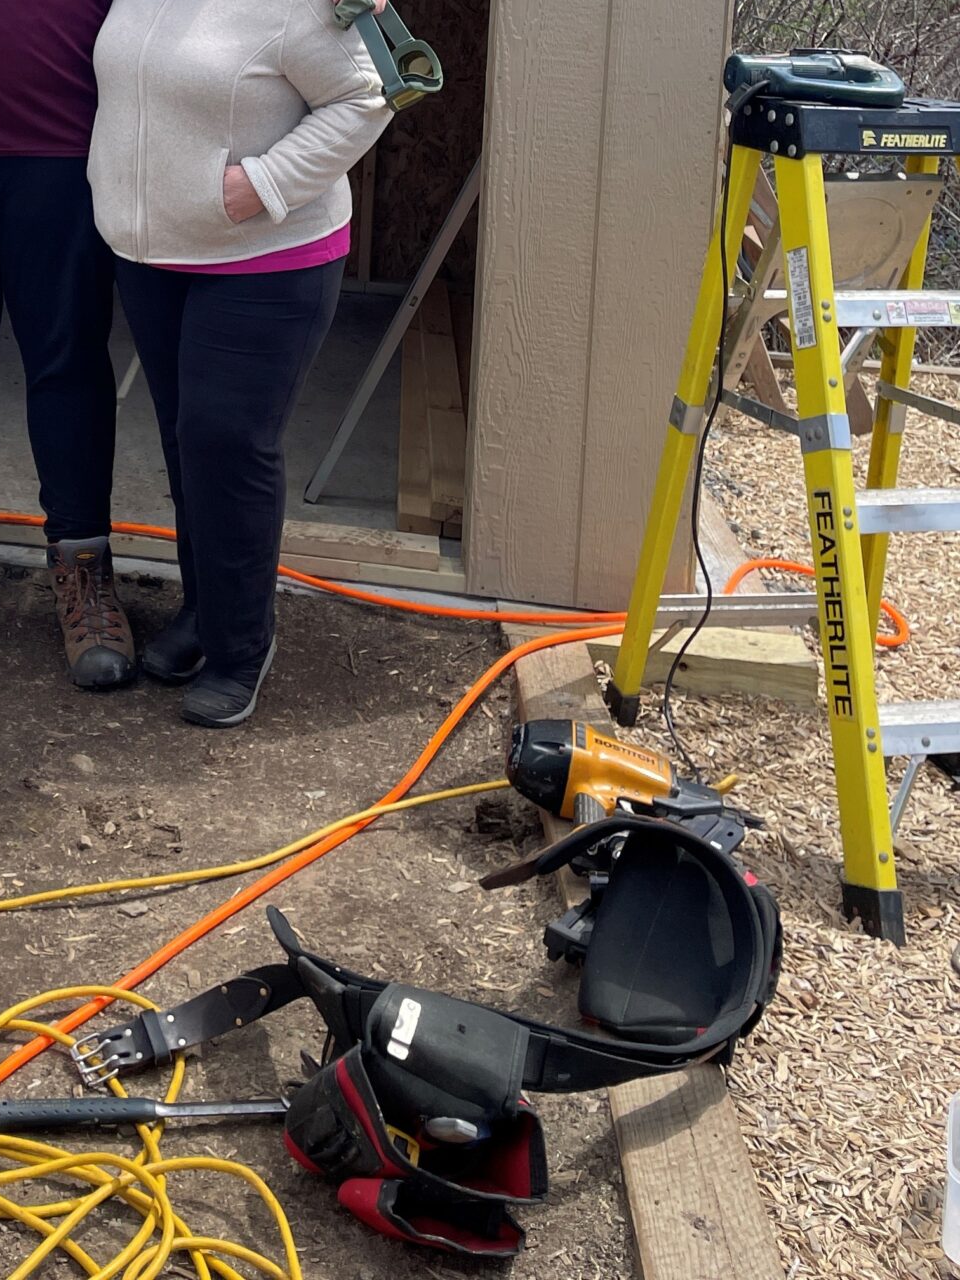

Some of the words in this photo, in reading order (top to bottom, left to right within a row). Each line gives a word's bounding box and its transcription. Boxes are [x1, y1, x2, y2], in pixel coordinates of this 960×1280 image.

[880, 133, 948, 148] FEATHERLITE
[813, 490, 854, 717] FEATHERLITE
[594, 737, 656, 766] BOSTITCH
